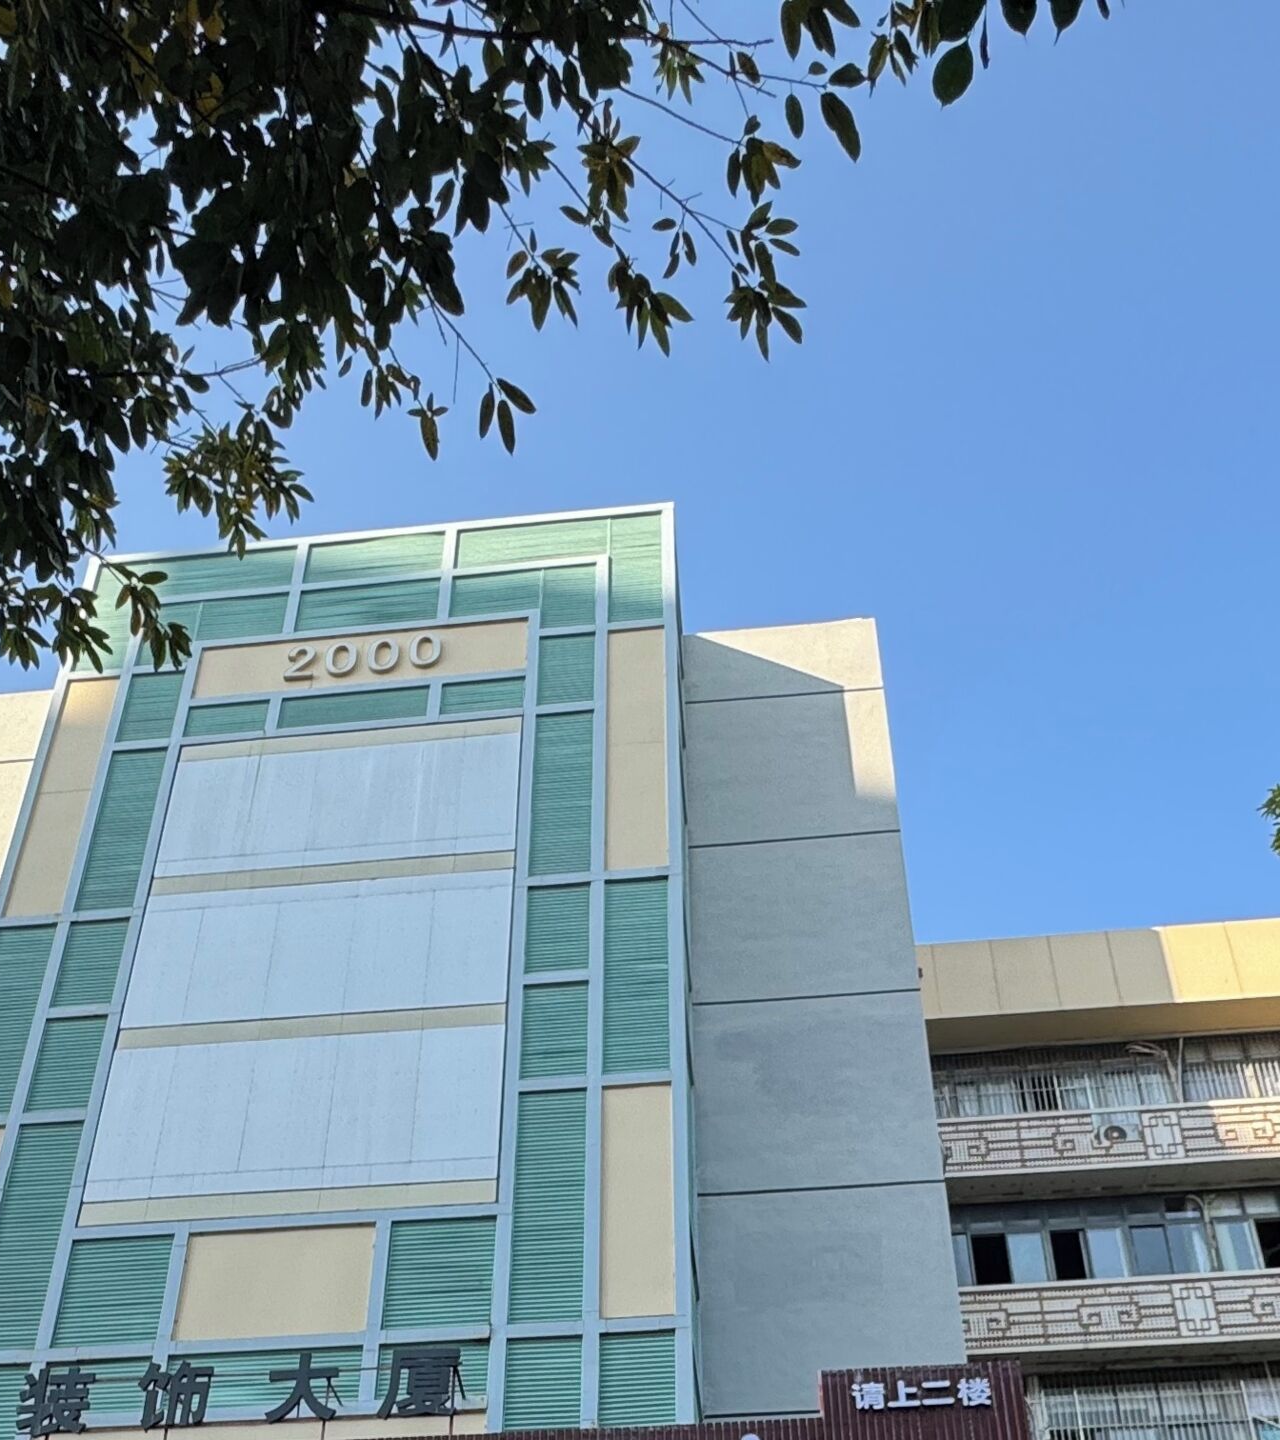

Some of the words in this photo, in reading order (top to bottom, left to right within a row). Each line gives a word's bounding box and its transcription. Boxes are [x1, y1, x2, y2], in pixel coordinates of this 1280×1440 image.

[283, 632, 442, 682] 2000
[16, 1348, 461, 1438] 装饰大厦
[851, 1377, 992, 1412] 请上二楼
